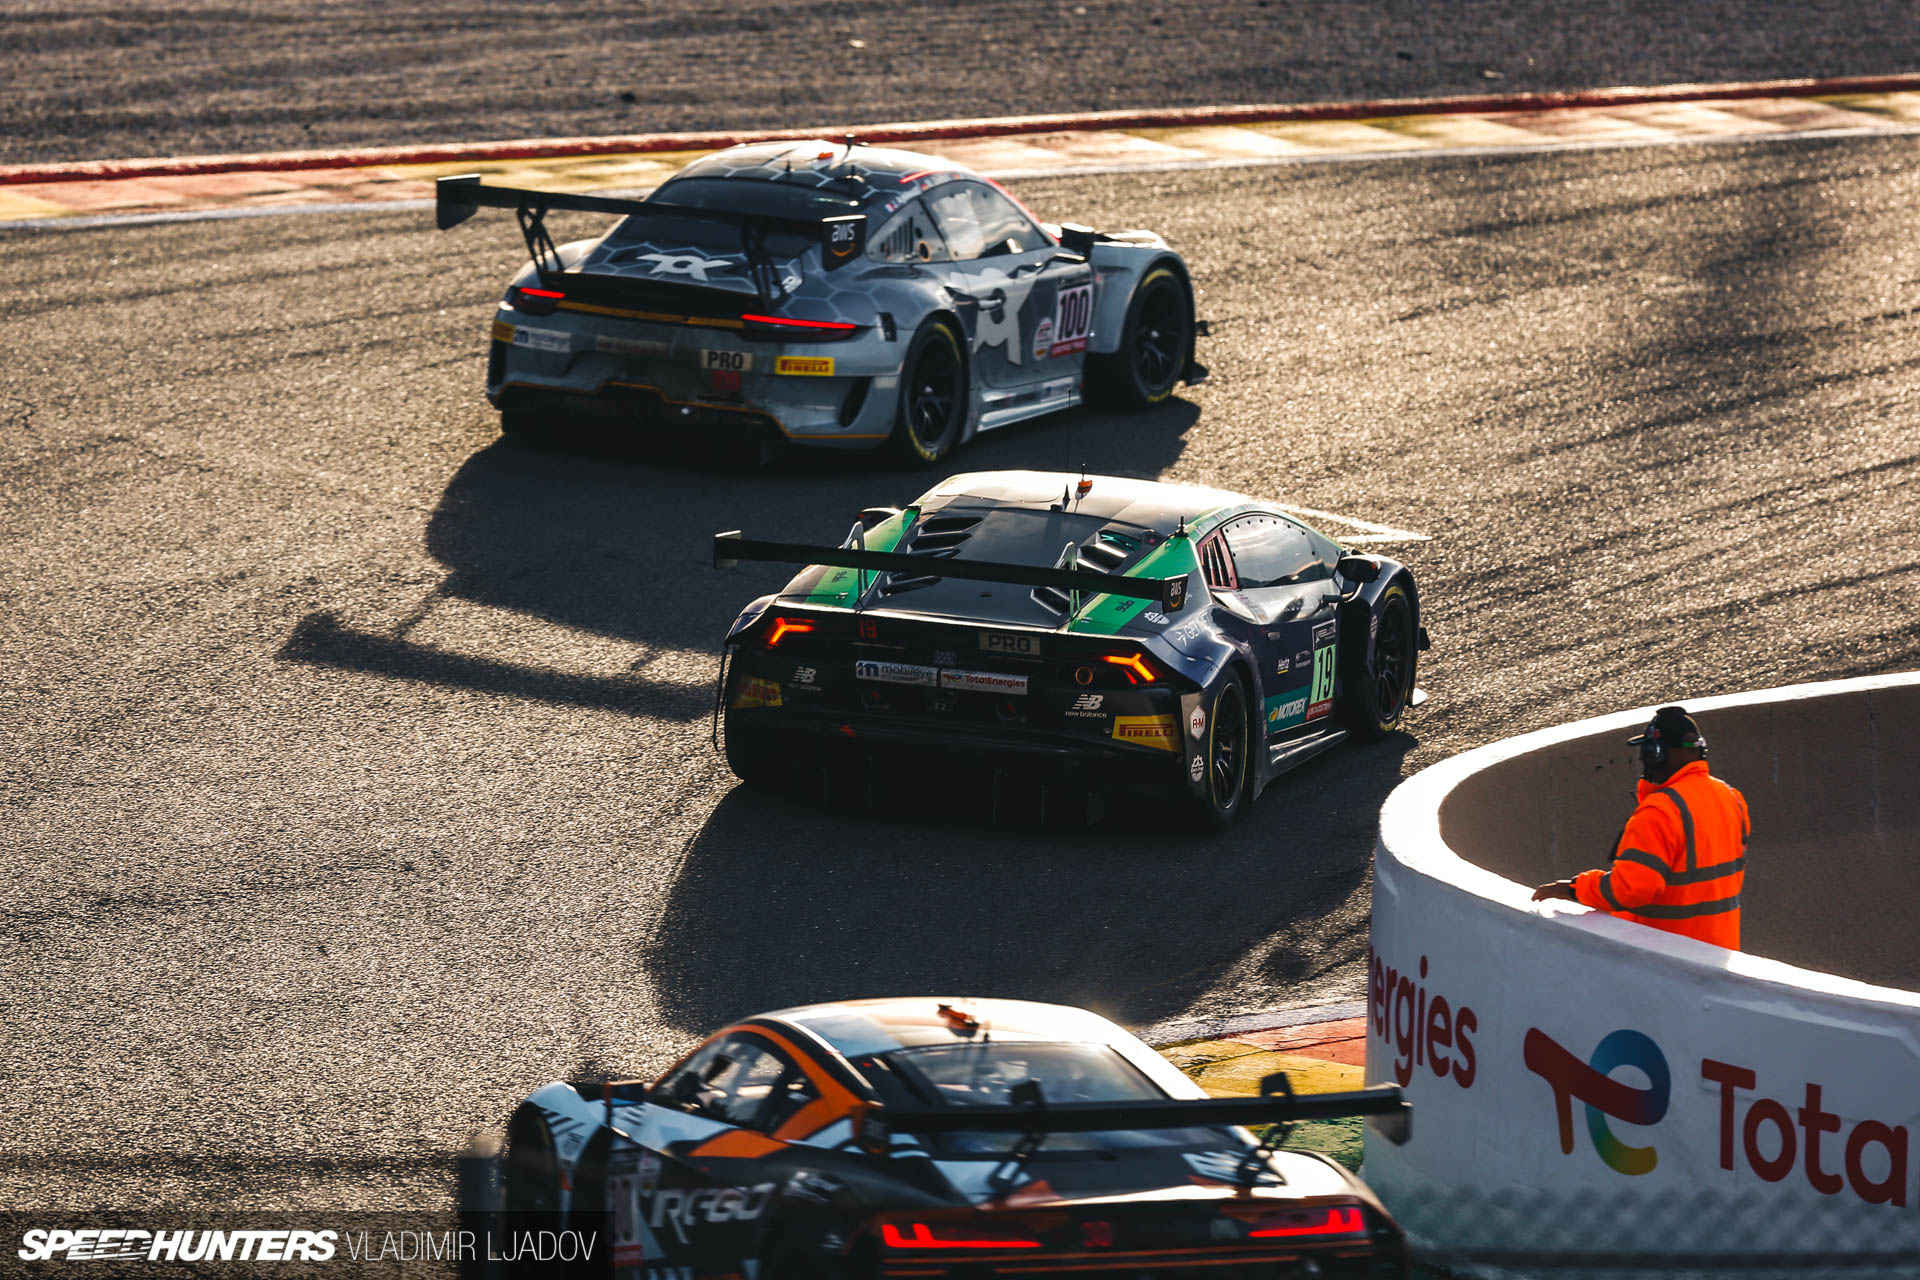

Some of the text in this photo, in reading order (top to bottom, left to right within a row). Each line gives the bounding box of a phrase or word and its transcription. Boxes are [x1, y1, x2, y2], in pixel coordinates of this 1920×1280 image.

[832, 223, 856, 242] aws
[1058, 289, 1089, 341] 100
[707, 351, 744, 370] PRO
[780, 358, 829, 372] PIRELLI
[857, 618, 878, 639] 19
[988, 634, 1031, 652] PRO
[881, 664, 933, 680] mobileye
[965, 674, 1025, 688] TotalEnergies
[1315, 646, 1333, 702] 19
[1080, 711, 1107, 719] balance
[1277, 697, 1308, 721] MOTOREX
[1119, 723, 1175, 737] PIRELLI
[1701, 1057, 1920, 1210] Tota
